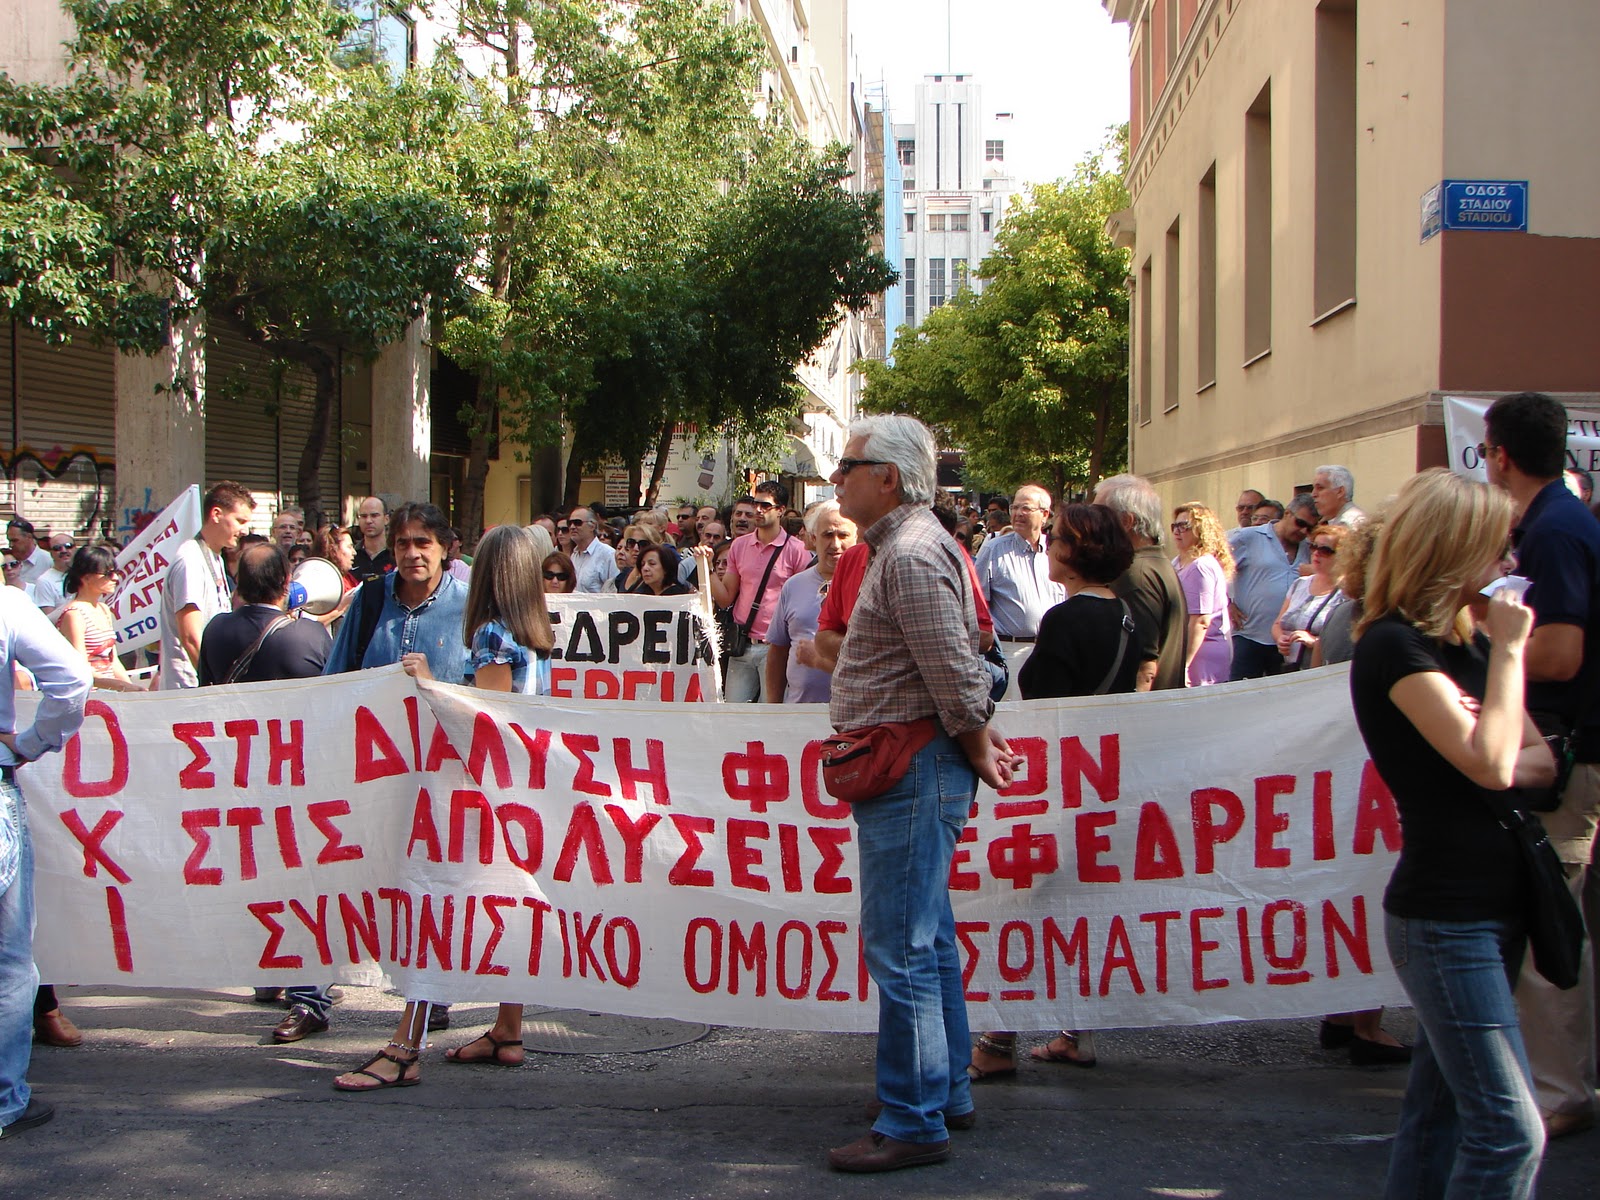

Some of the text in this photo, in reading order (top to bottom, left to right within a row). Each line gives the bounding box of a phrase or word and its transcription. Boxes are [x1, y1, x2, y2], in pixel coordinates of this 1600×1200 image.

[1459, 199, 1512, 210] ΣΤΑΔΙΟΥ
[1465, 185, 1507, 196] ΟΔΟΣ
[1458, 212, 1511, 223] STADIOU
[173, 696, 1120, 820] ΣΤΗ ΔΙΑΛΥΣΗ ΦΟΩΝ
[181, 800, 364, 886] ΣΤΙΣ
[407, 786, 853, 894] ΑΠΟΛΥΣΕΙΣ
[683, 917, 870, 1002] ΟΜΟΣ
